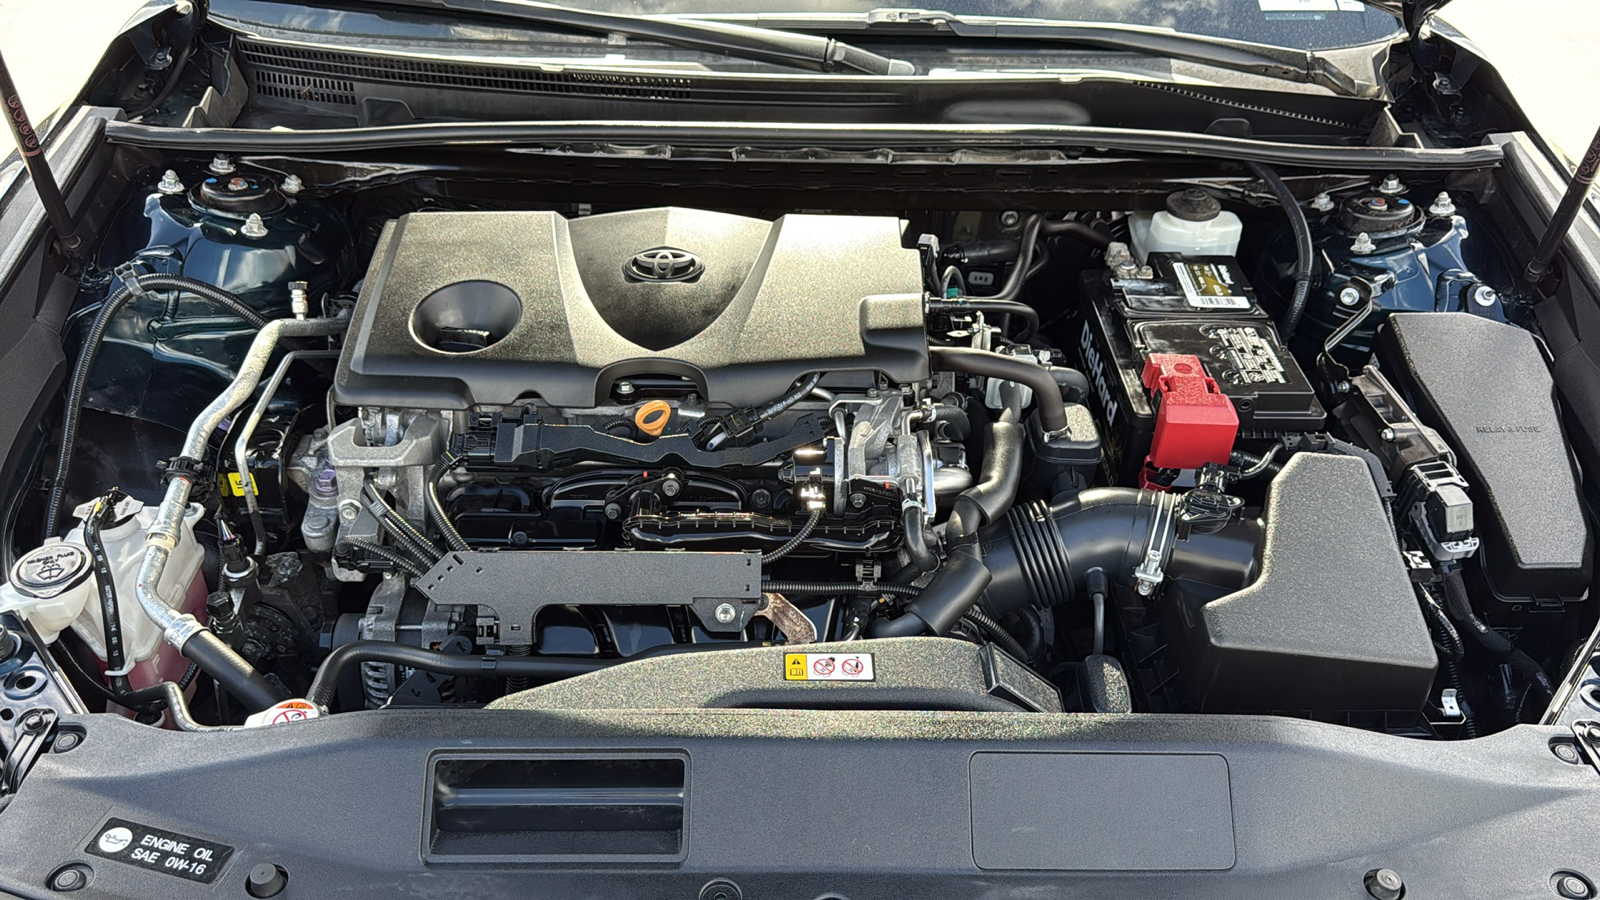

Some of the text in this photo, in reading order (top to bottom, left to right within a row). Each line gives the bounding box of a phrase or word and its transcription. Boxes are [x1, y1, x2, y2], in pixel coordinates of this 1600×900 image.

[1081, 319, 1118, 427] DieHard
[131, 848, 206, 874] SAE 0W-16
[141, 834, 213, 861] ENGINE OIL
